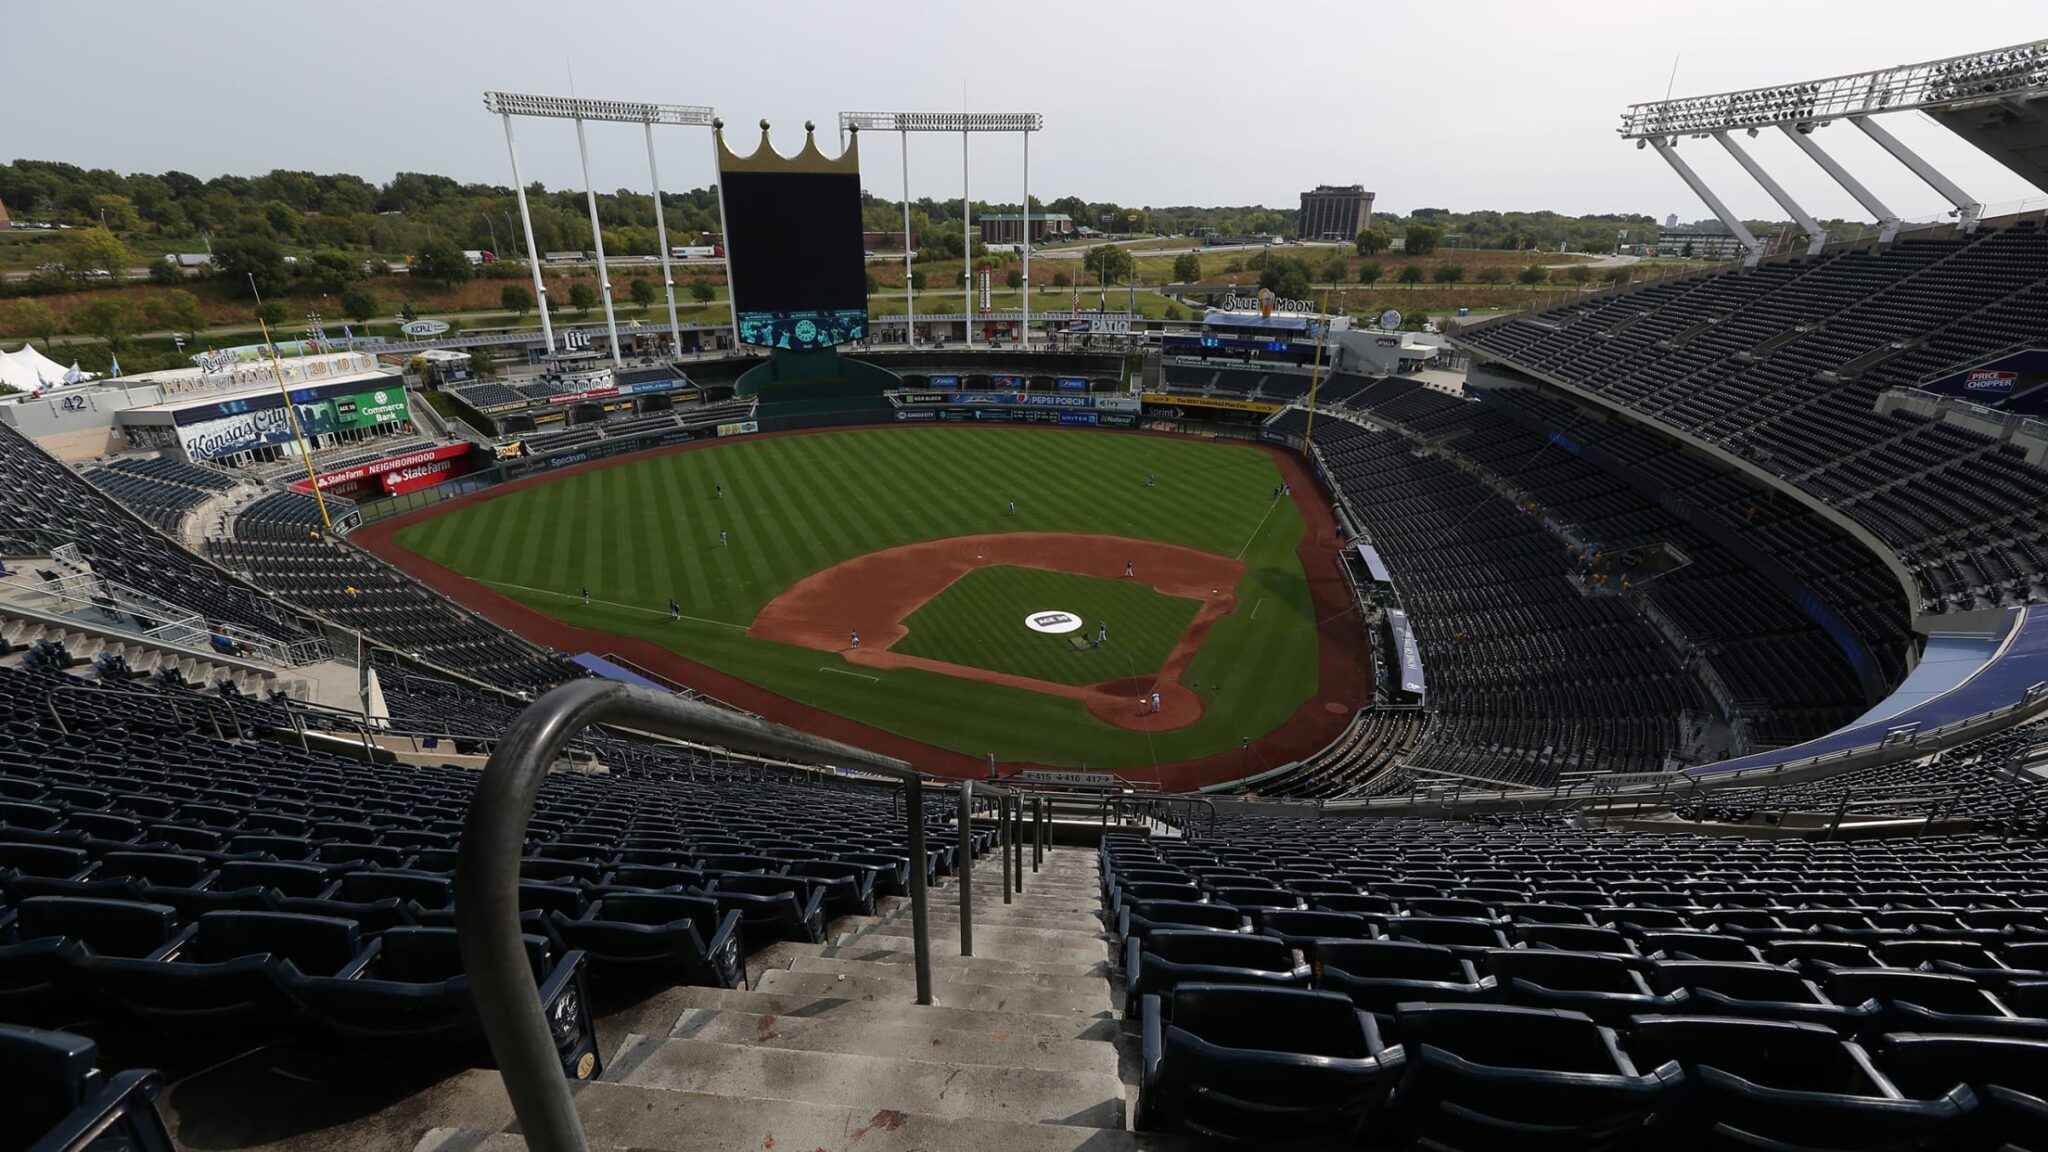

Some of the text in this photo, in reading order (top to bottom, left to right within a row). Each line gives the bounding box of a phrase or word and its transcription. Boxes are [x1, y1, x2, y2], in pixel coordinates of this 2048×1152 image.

[1223, 292, 1314, 313] BLUE MOON
[1091, 320, 1129, 332] PATIO
[563, 332, 591, 351] Lite
[197, 350, 239, 374] Royals
[1967, 379, 2012, 388] CHOPPER
[1972, 372, 1999, 380] PRICE
[163, 374, 215, 395] HALL
[64, 395, 87, 410] 42
[362, 402, 404, 415] Commerce
[1032, 396, 1085, 406] PEPSI PORCH
[375, 412, 396, 421] Bank
[187, 422, 252, 460] Kansas
[254, 407, 288, 432] City
[369, 452, 435, 475] NEIGHBORHOOD
[551, 452, 587, 467] Spectrum
[1064, 774, 1080, 782] 416
[1086, 775, 1101, 783] 417
